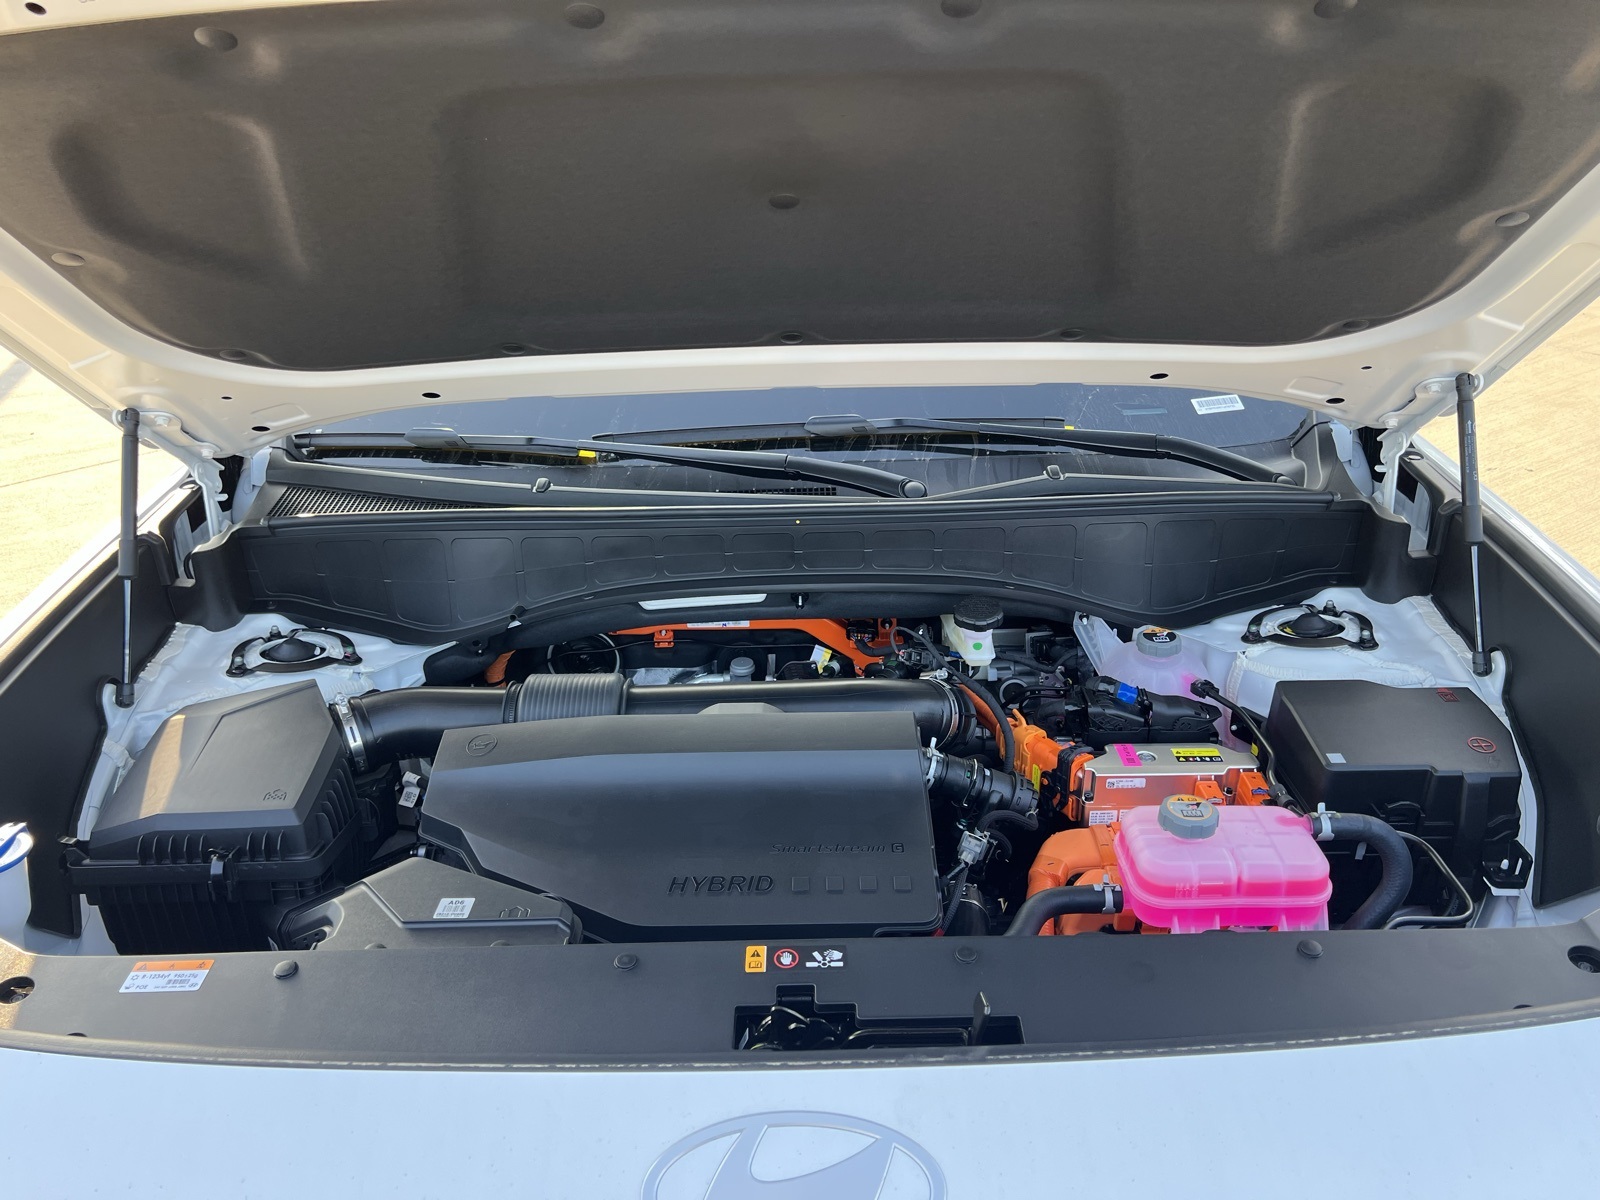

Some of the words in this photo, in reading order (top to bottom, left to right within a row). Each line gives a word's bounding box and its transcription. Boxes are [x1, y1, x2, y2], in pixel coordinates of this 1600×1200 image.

[770, 843, 886, 854] Smartstream
[891, 842, 905, 853] G
[667, 875, 775, 894] HYBRID
